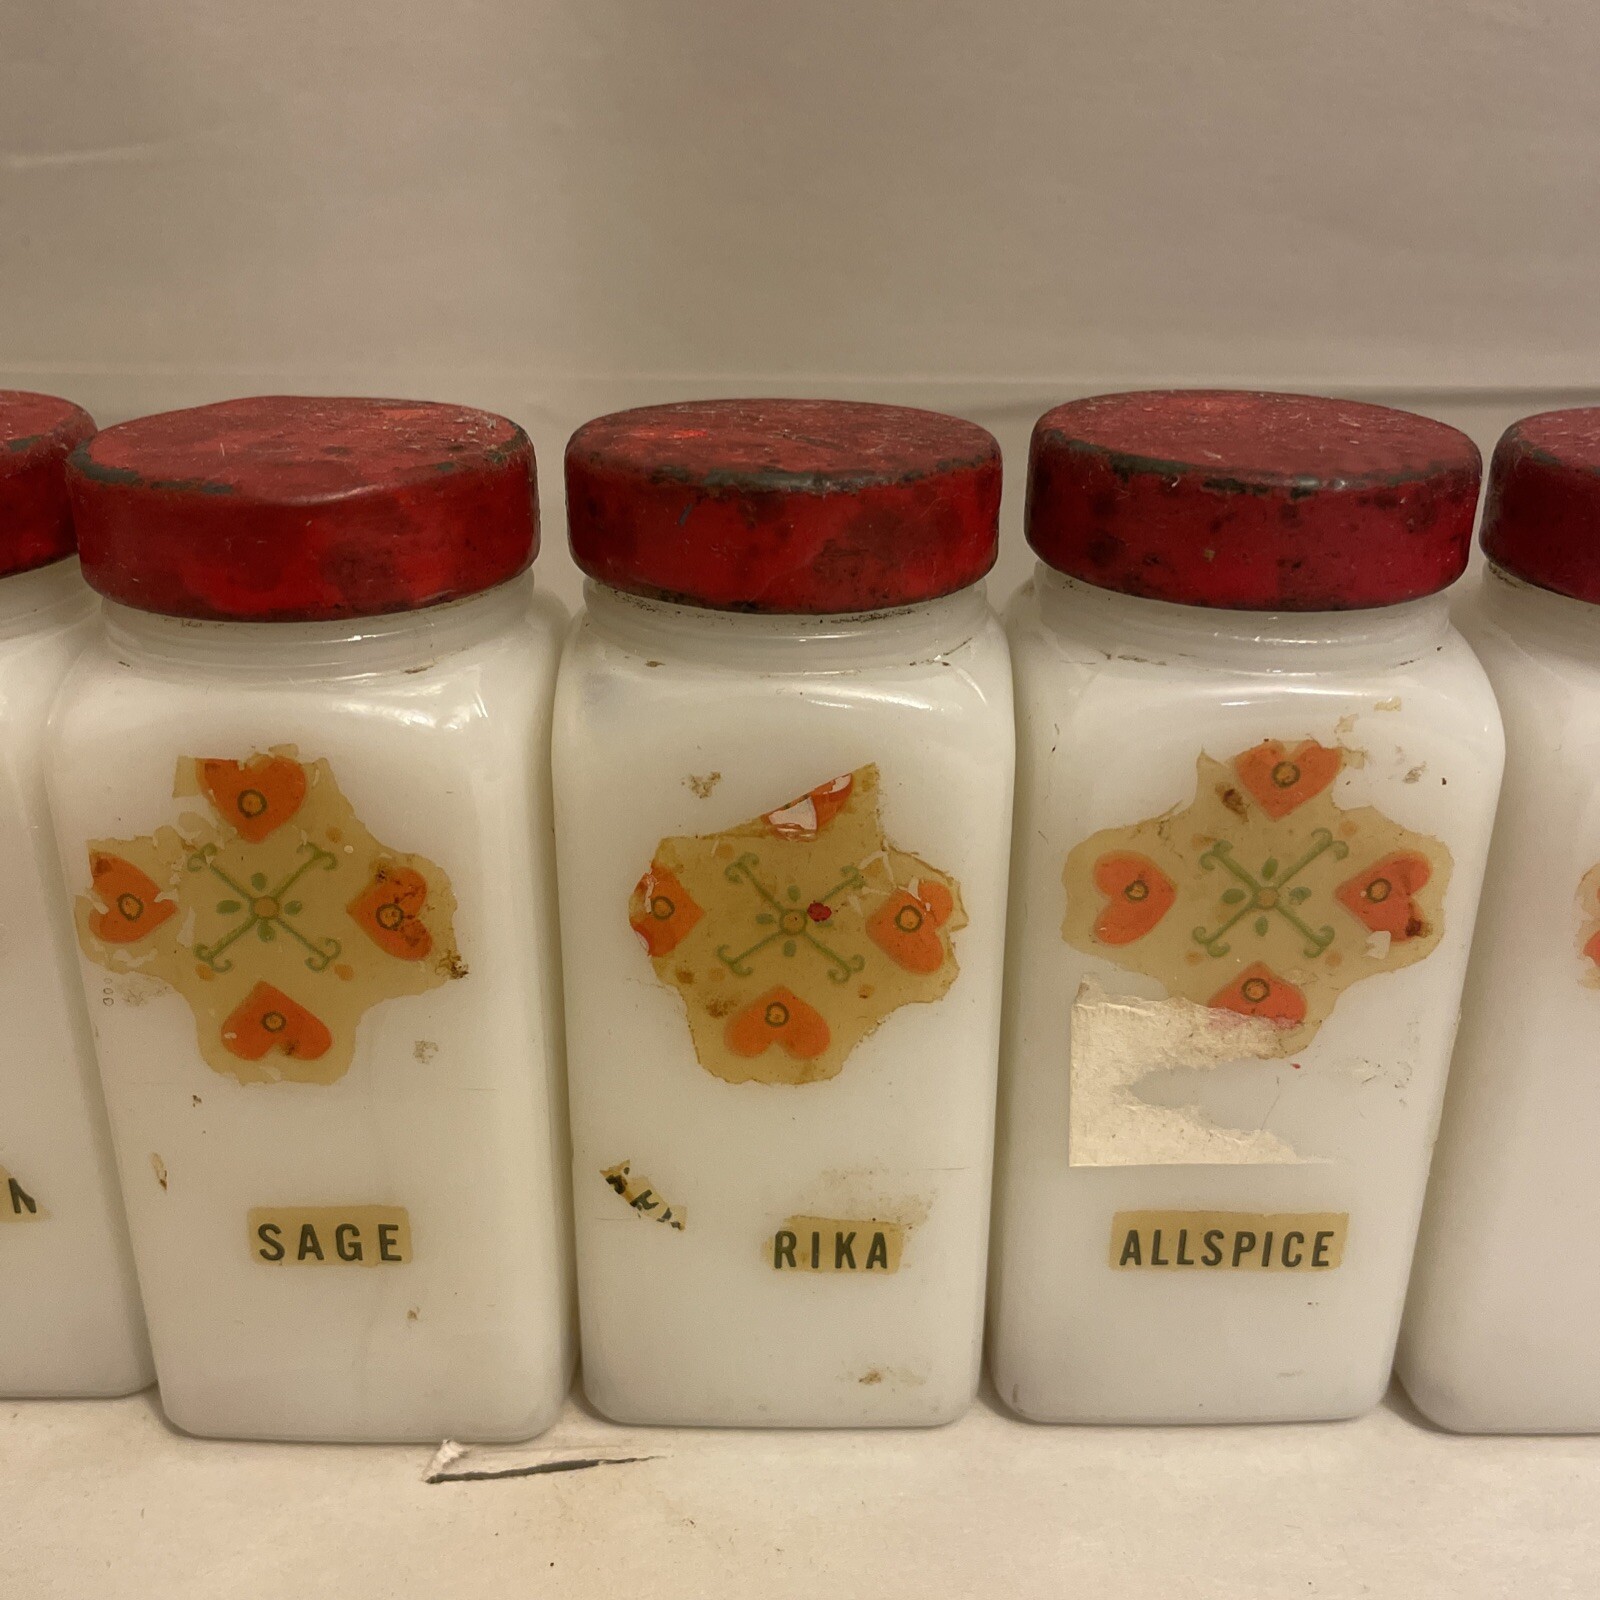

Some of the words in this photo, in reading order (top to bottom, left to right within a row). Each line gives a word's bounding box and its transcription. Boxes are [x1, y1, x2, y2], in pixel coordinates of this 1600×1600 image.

[258, 1223, 402, 1262] SAGE
[774, 1230, 888, 1270] RIKA
[1118, 1229, 1335, 1267] ALLSPICE
